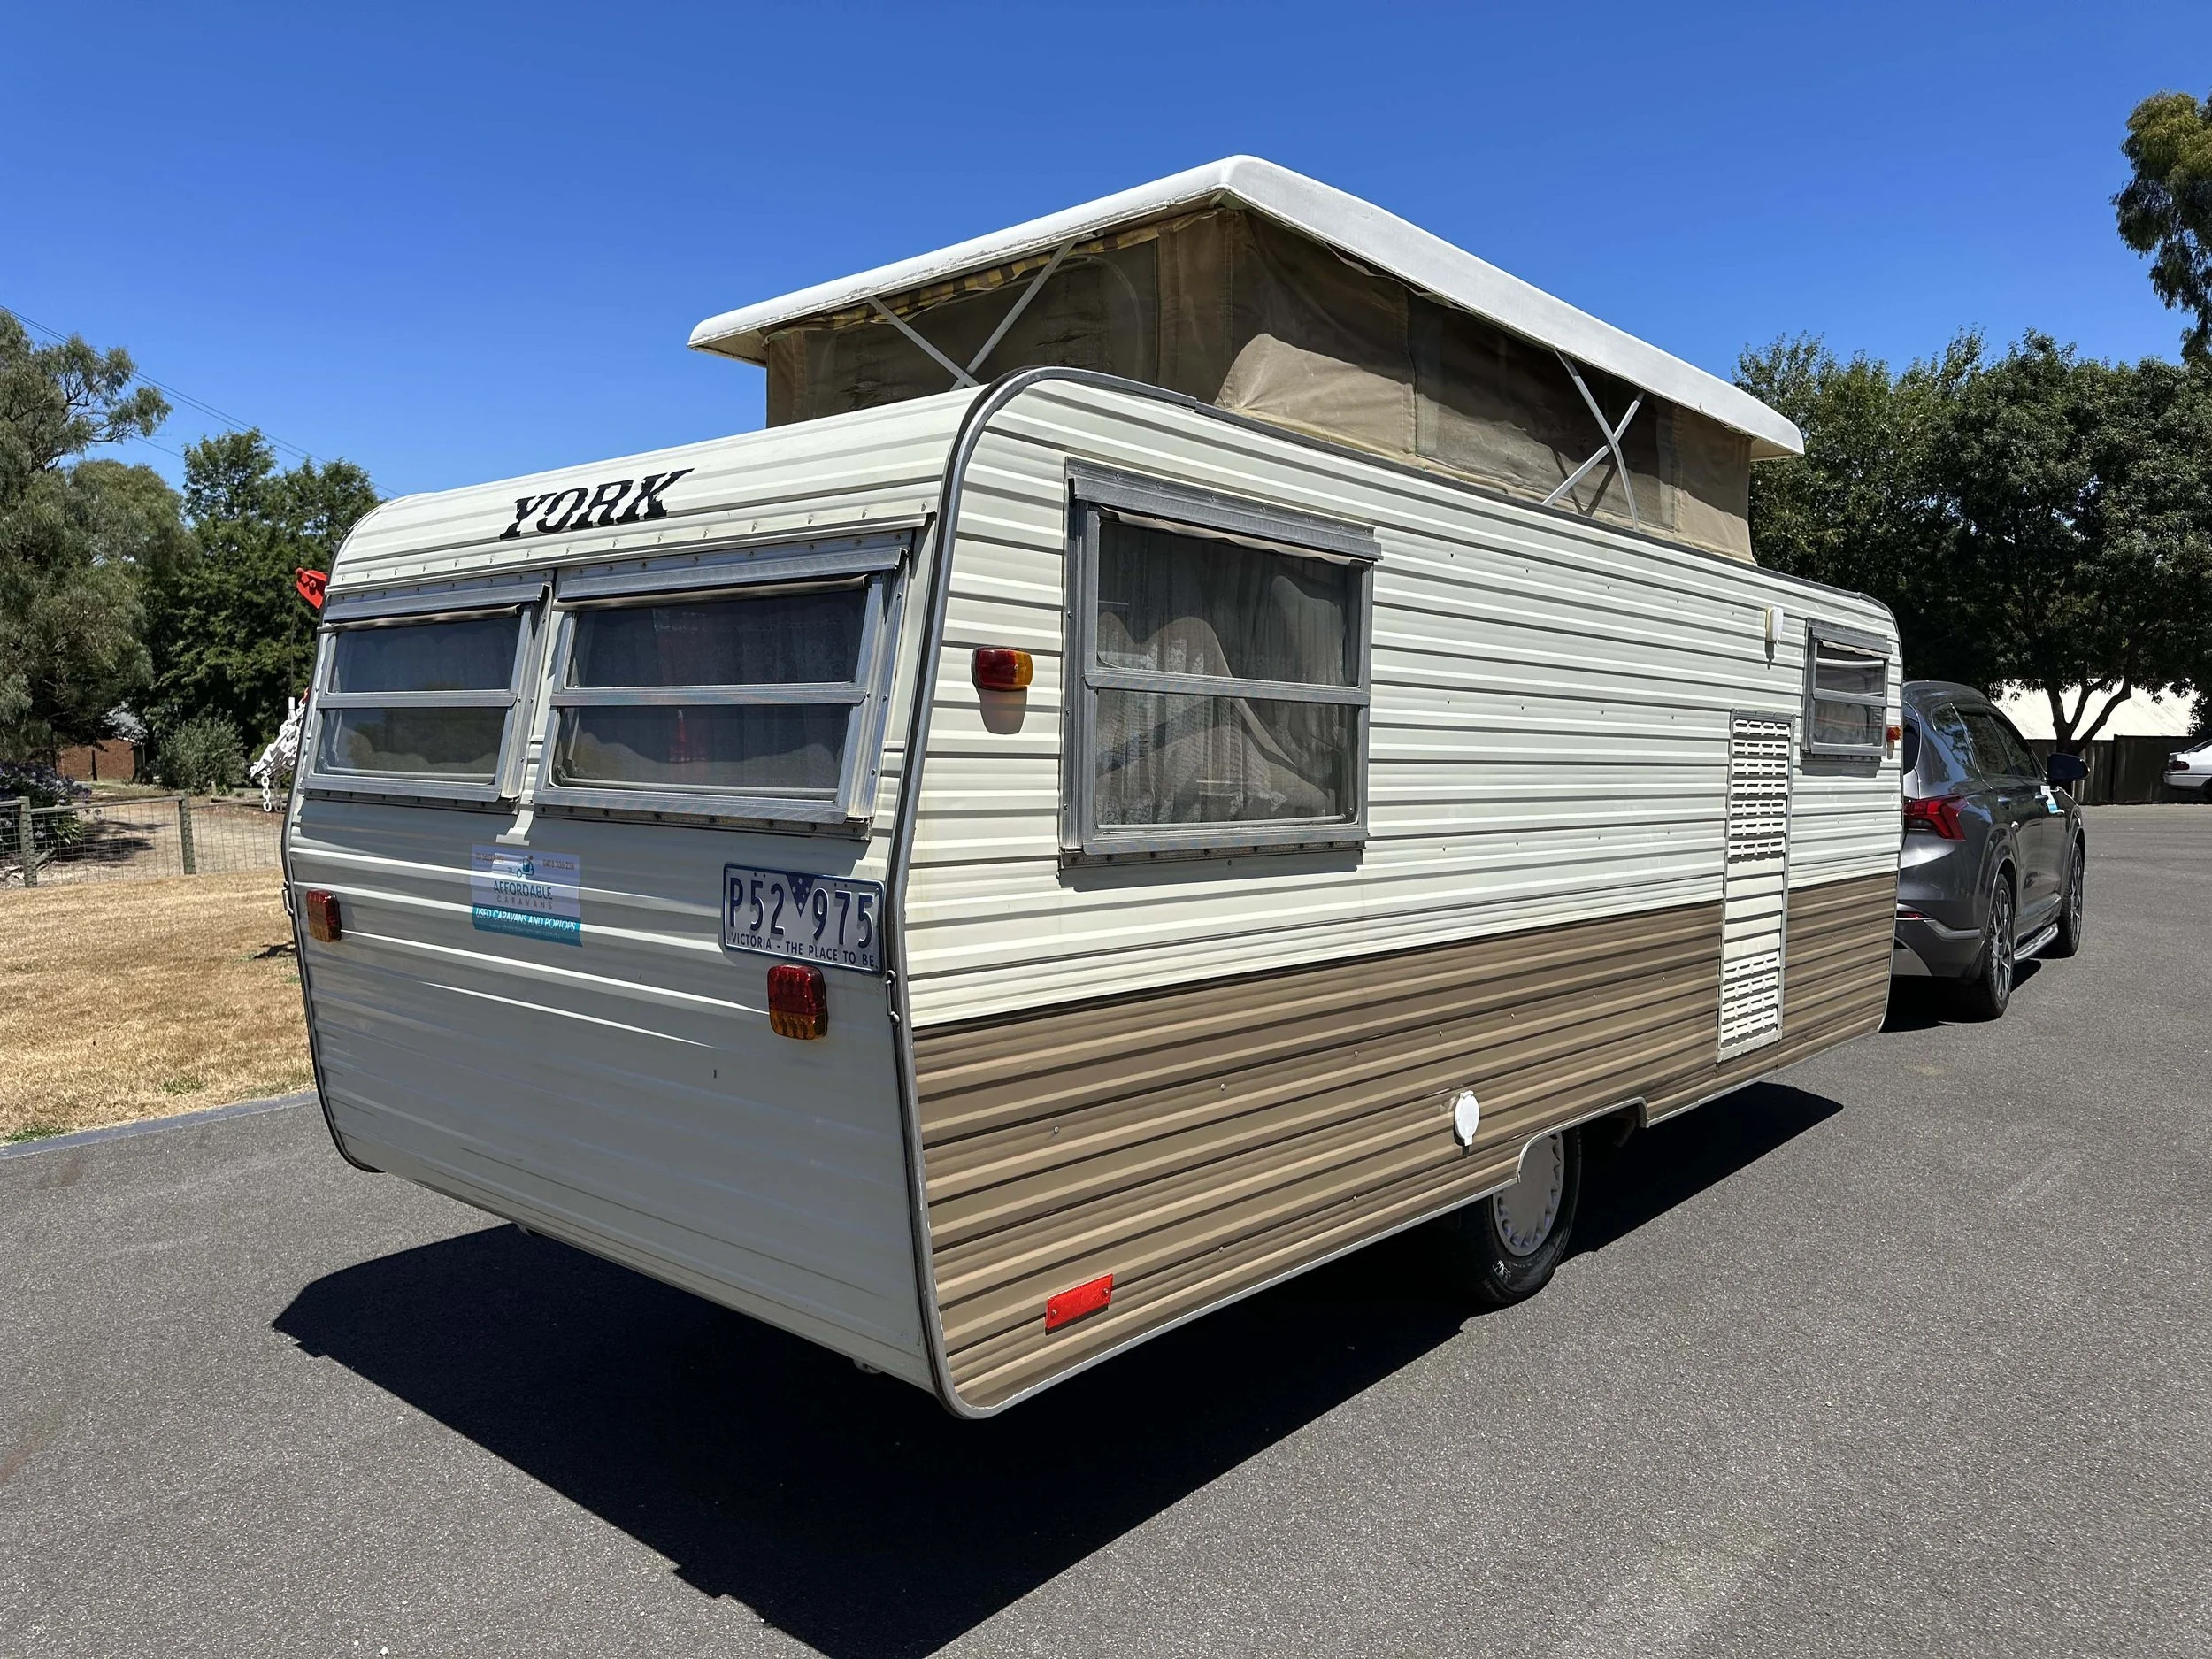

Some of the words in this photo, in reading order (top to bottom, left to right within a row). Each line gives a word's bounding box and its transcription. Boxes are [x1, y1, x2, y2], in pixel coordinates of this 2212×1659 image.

[500, 468, 695, 540] YORK
[494, 880, 553, 900] AFFORDABLE
[496, 895, 553, 910] CARAVANS
[475, 907, 492, 920] USED
[492, 910, 527, 925] CARAVANS
[528, 915, 543, 927] AND
[544, 918, 576, 933] POPTOPS
[730, 877, 785, 936] P52
[812, 887, 874, 949] 975
[732, 933, 772, 949] VICTORIA
[786, 941, 803, 956] THE
[809, 945, 838, 962] PLACE
[843, 950, 856, 964] TO
